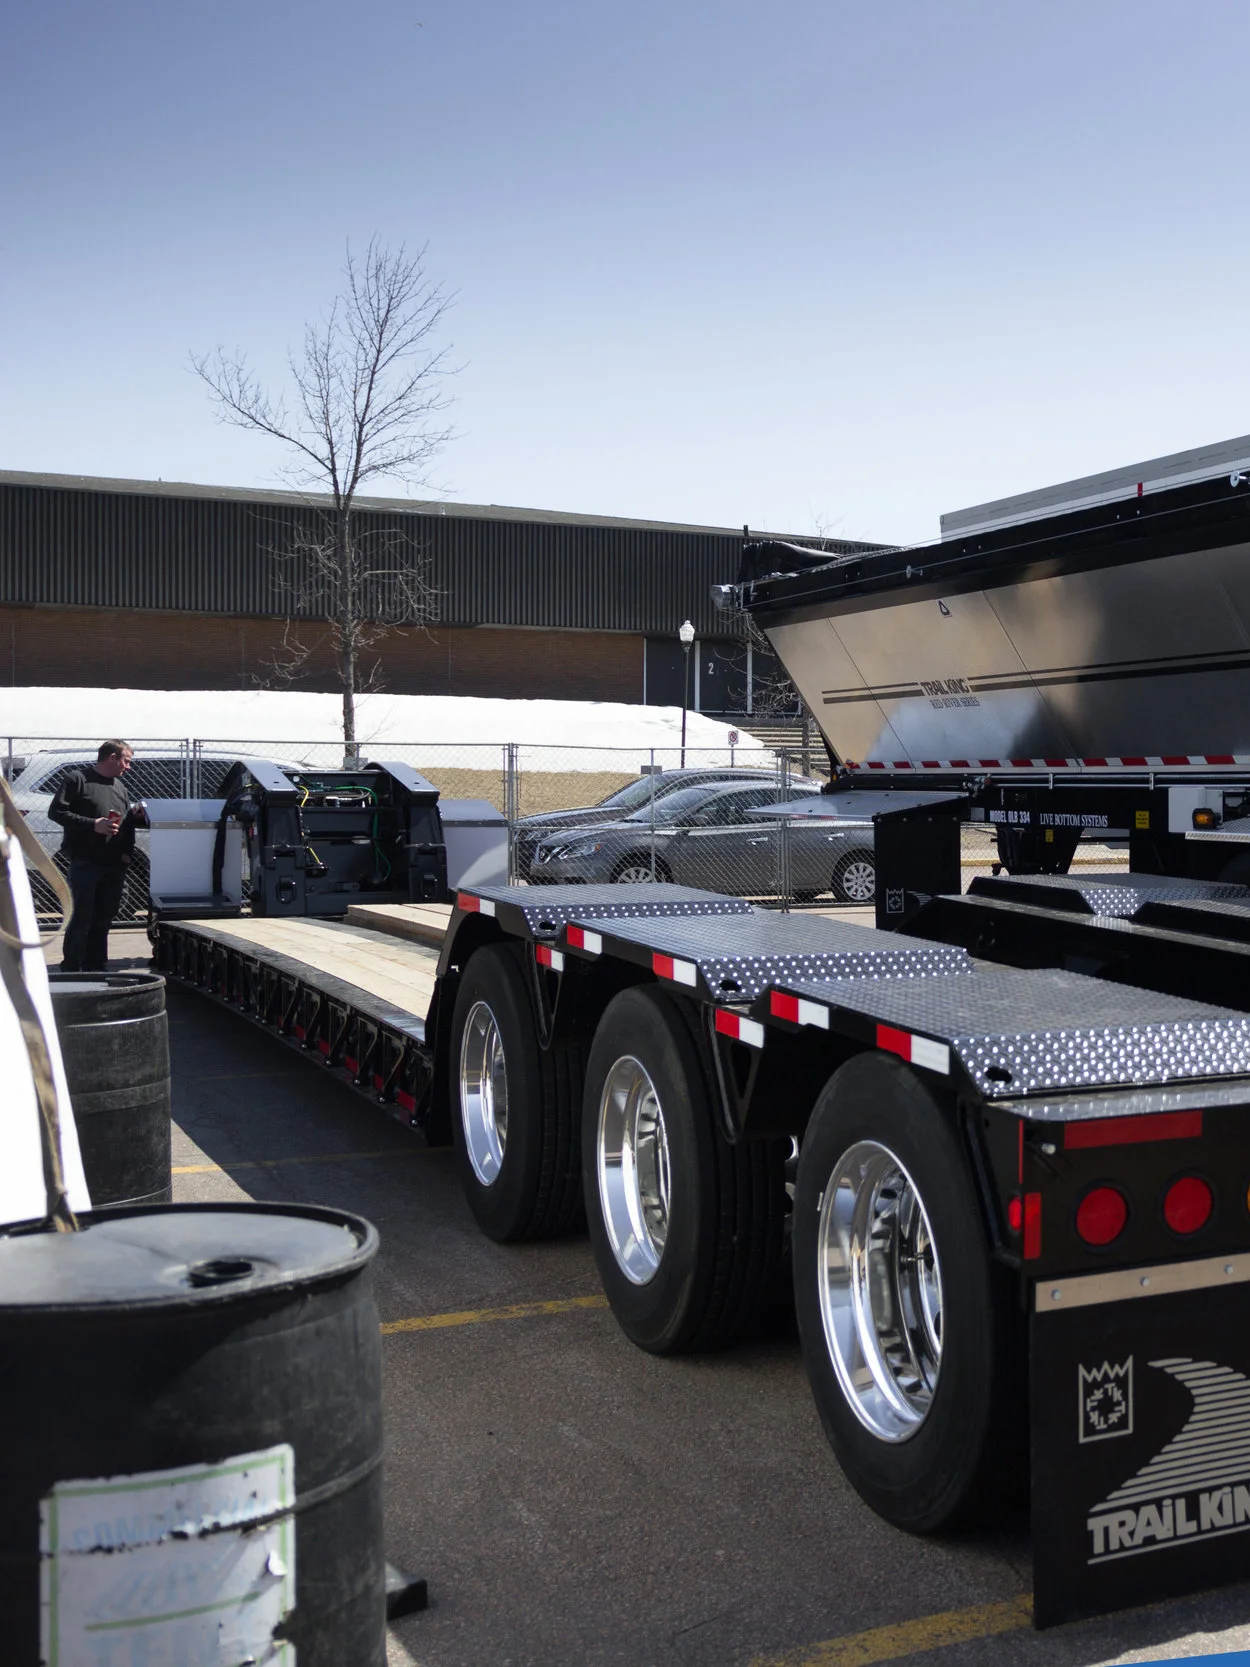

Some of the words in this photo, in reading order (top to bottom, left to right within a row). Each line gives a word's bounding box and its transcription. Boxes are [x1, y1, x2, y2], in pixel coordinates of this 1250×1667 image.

[708, 662, 714, 675] 2
[989, 810, 1007, 822] MODEL
[1019, 811, 1031, 824] 334
[1040, 813, 1054, 825] LIVE
[1054, 813, 1080, 826] BOTTOM
[1081, 814, 1108, 828] SYSTEMS
